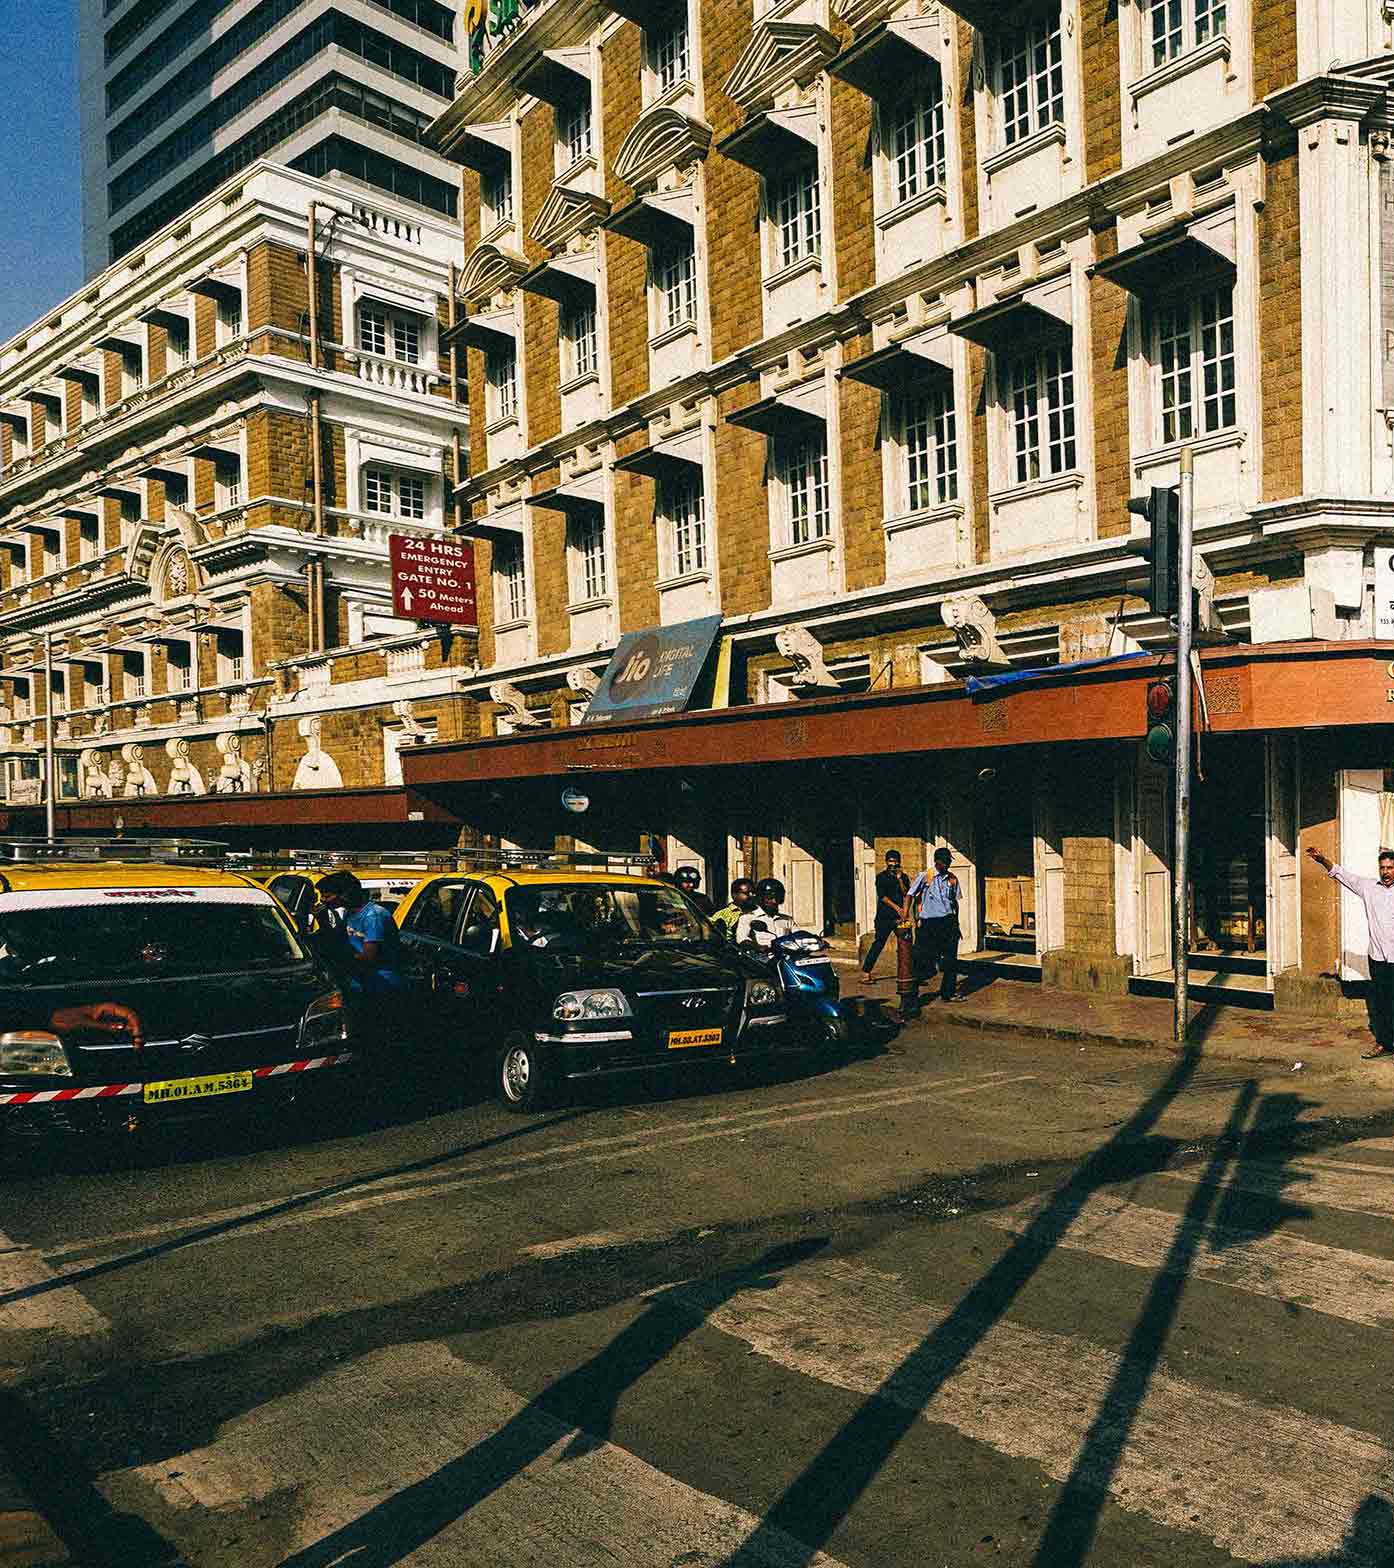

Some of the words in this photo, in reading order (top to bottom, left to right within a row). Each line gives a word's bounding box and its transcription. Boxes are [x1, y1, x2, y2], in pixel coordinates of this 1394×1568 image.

[404, 539, 426, 551] 24
[430, 543, 463, 557] HRS
[400, 552, 468, 569] EMERGENCY
[417, 565, 453, 577] ENTRY
[397, 572, 432, 584] GATE
[436, 577, 461, 589] NO.
[465, 582, 472, 590] 1
[418, 588, 436, 600] 50
[439, 593, 474, 604] Meters
[430, 602, 464, 613] Ahead
